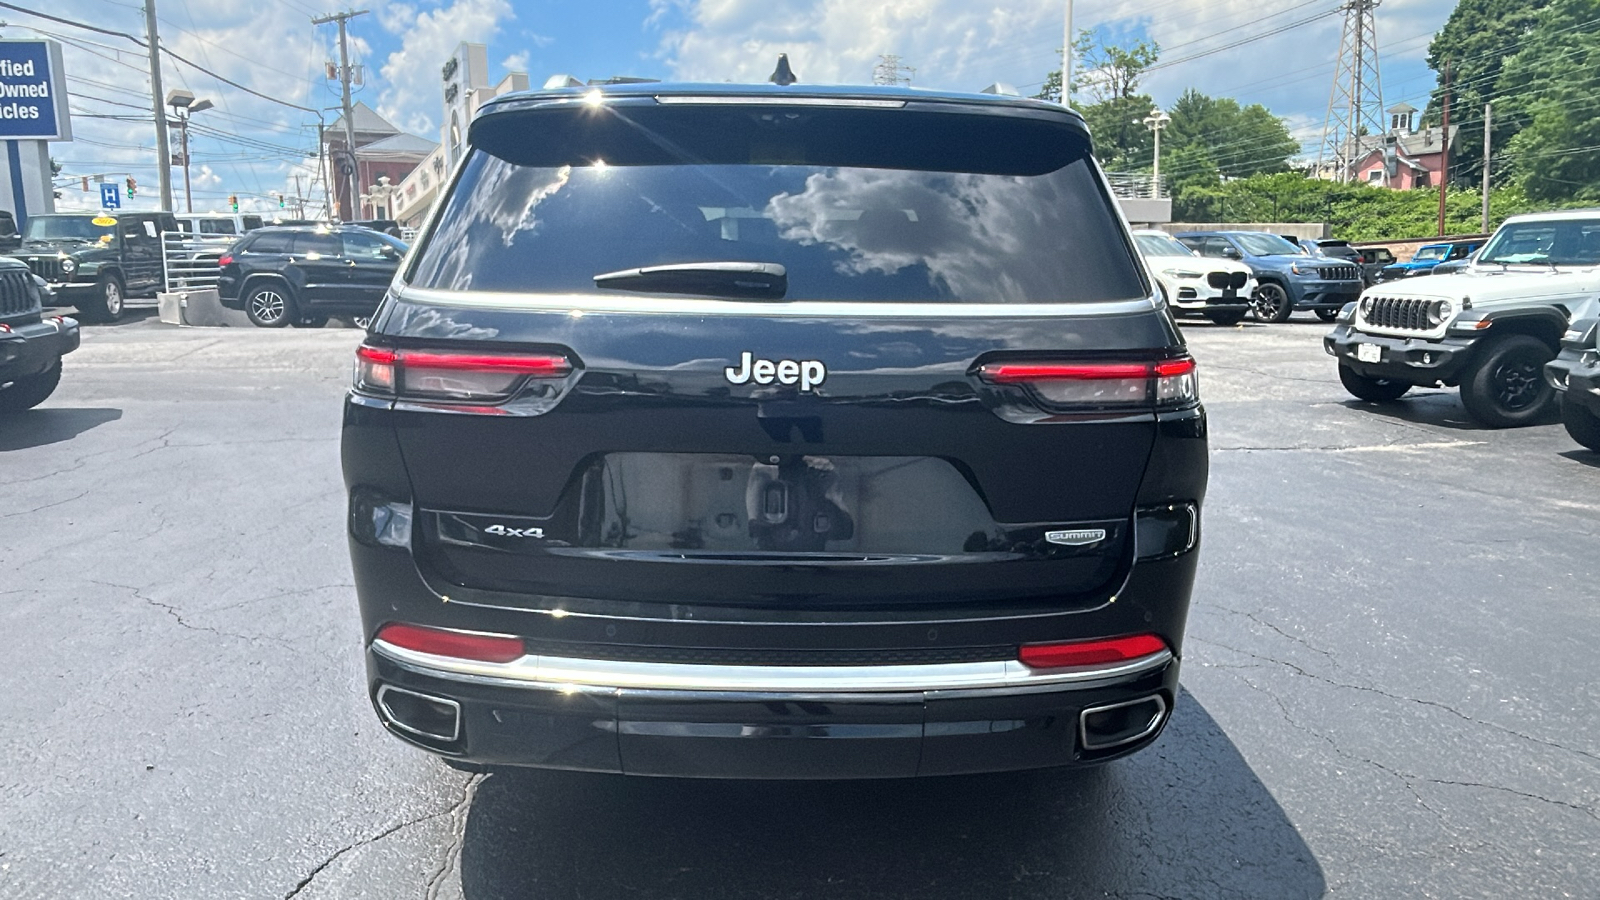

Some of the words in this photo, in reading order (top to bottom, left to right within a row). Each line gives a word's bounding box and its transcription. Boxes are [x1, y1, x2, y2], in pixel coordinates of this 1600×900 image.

[104, 188, 116, 201] H
[724, 351, 826, 392] Jeep
[484, 524, 545, 539] 4x4
[1050, 531, 1102, 540] SUMMIT
